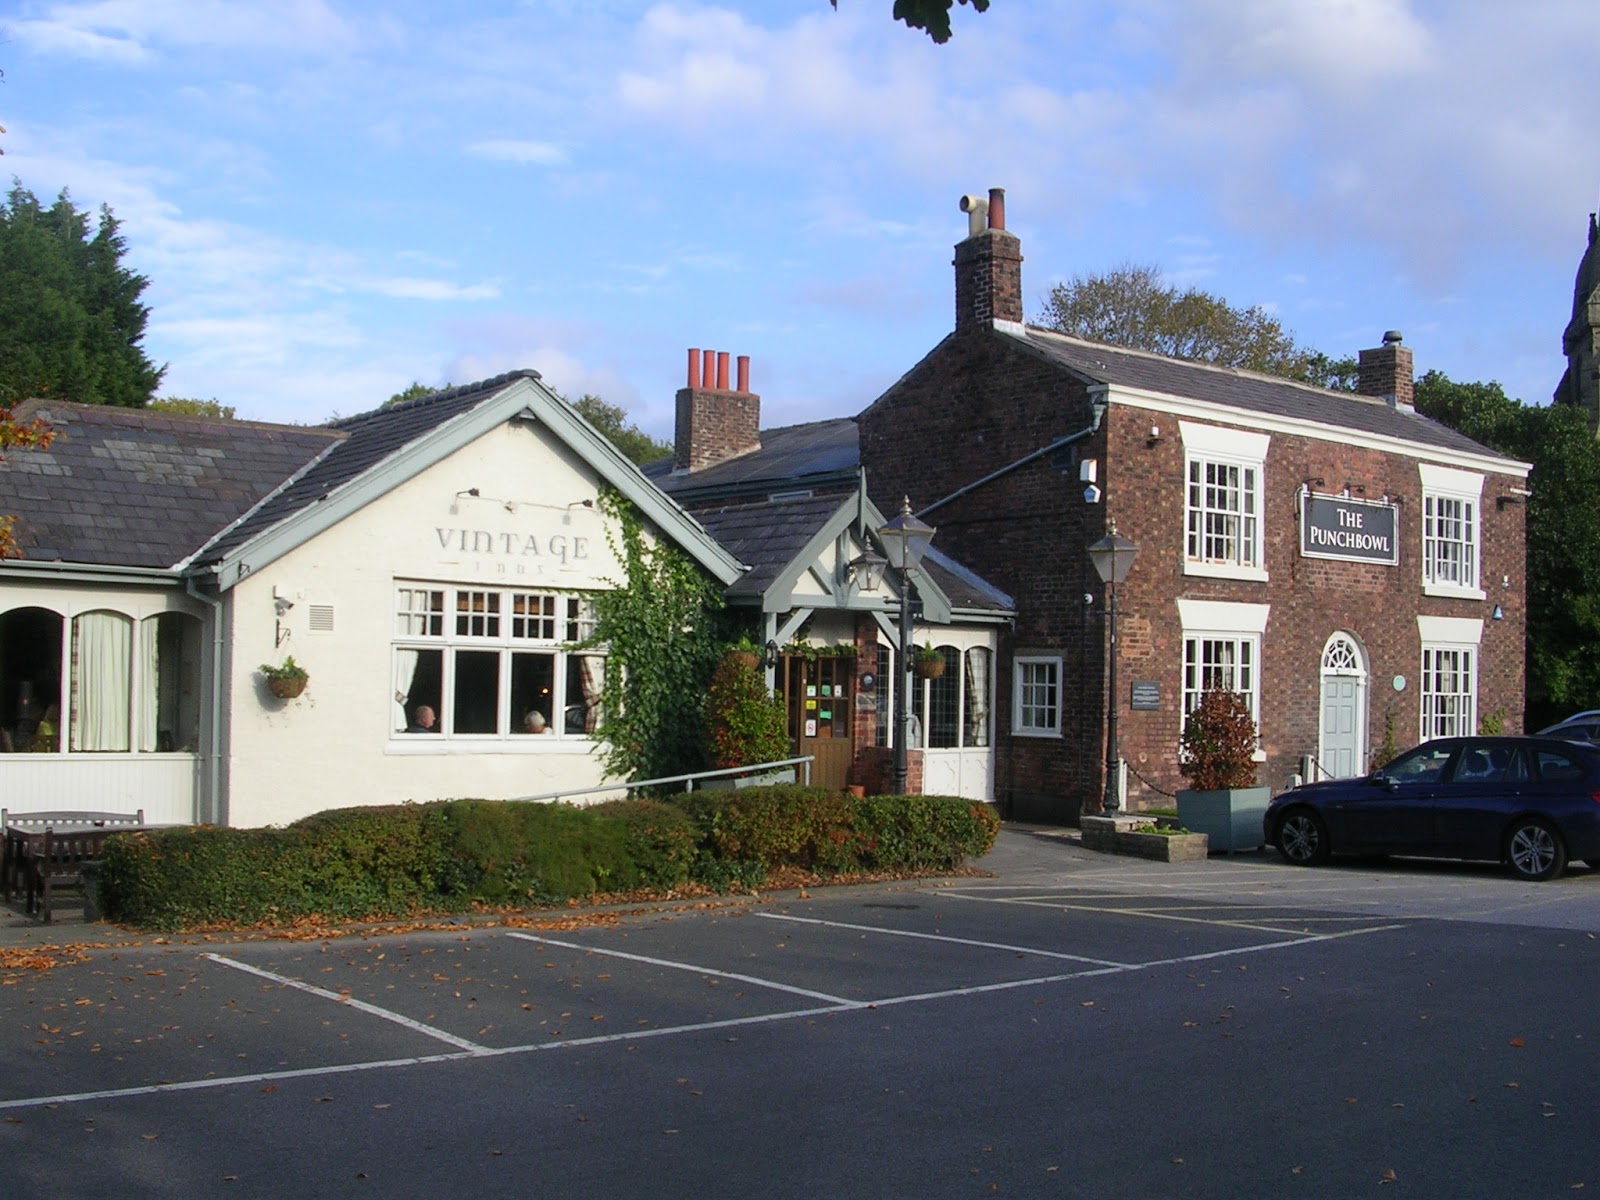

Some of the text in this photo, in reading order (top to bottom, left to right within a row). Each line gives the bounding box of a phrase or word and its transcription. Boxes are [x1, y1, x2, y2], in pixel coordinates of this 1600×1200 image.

[1337, 508, 1363, 528] THE
[436, 527, 588, 564] VINTAGE
[1310, 526, 1390, 552] PUNCHBOWL
